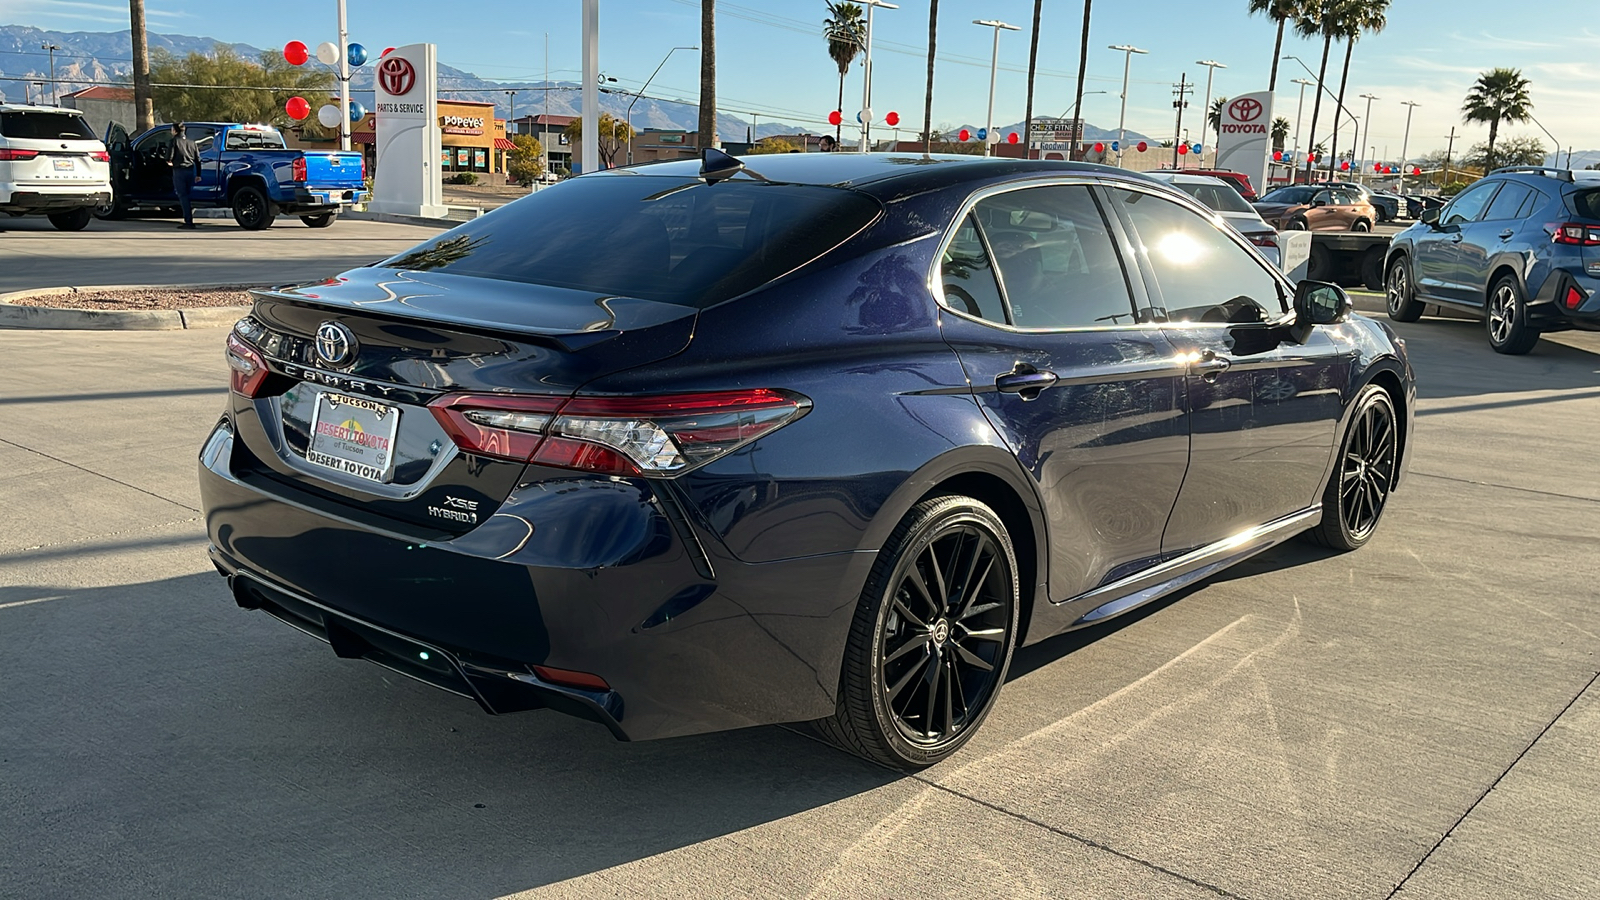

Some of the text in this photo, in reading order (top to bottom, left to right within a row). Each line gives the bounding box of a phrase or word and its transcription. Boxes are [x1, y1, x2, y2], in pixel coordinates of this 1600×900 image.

[377, 103, 424, 113] PARTS & SERVICE
[1221, 124, 1267, 134] TOYOTA
[284, 366, 397, 395] CAMRY
[337, 395, 377, 412] TUCSON
[317, 421, 390, 452] DESERT TOYOTA
[334, 439, 364, 456] of Tucson
[309, 451, 382, 481] DESERT TOYOTA
[443, 495, 479, 511] XSE
[428, 506, 470, 523] HYBRID
